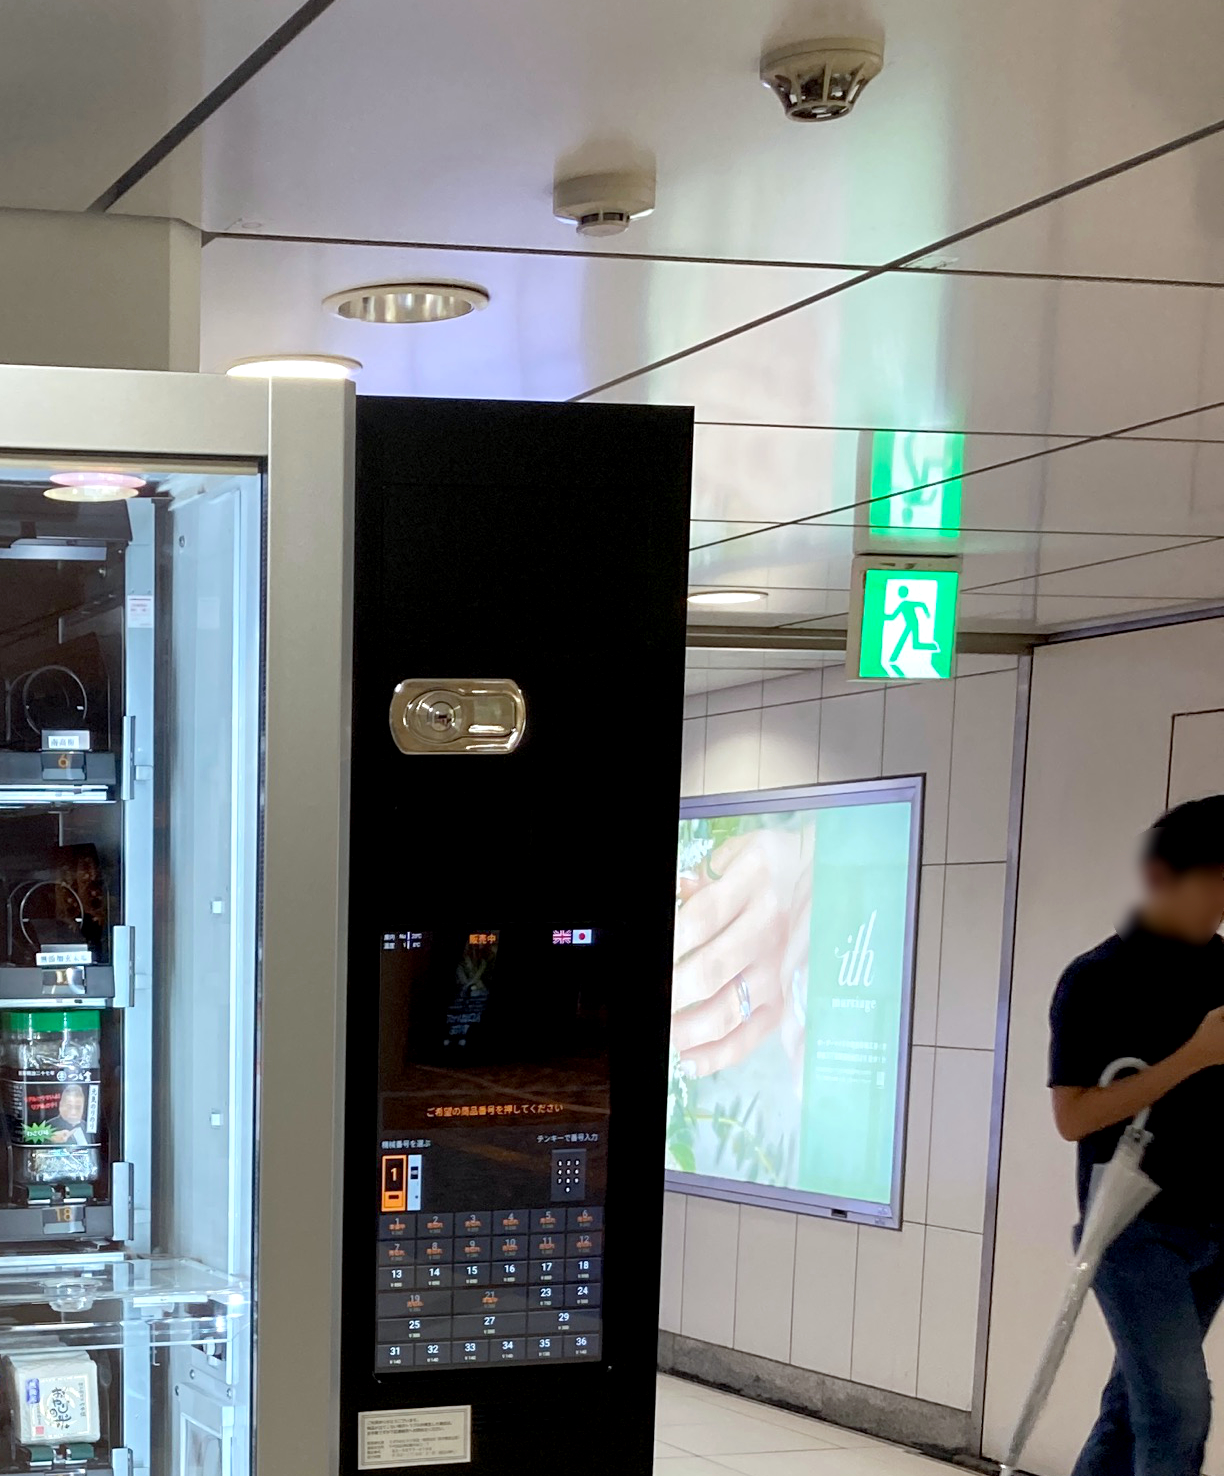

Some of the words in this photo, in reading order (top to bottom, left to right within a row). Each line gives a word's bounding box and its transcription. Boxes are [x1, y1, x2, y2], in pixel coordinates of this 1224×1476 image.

[57, 752, 69, 768] 6
[469, 933, 497, 945] 販売中
[831, 997, 877, 1013] marriage
[89, 1086, 97, 1130] 元気のりのり
[427, 1104, 563, 1117] ご希望の商品番号を押してください
[536, 1133, 598, 1143] テンキーで番号入力
[382, 1139, 431, 1149] 機械番号を選ぶ
[390, 1168, 398, 1181] 1
[55, 1207, 73, 1222] 18
[504, 1264, 515, 1273] 16
[541, 1263, 552, 1271] 17
[578, 1261, 589, 1270] 18
[392, 1270, 402, 1279] 13
[429, 1268, 440, 1277] 14
[467, 1266, 478, 1275] 15
[540, 1288, 552, 1297] 23
[577, 1287, 588, 1296] 24
[484, 1317, 495, 1325] 27
[558, 1313, 570, 1322] 29
[409, 1320, 421, 1329] 25
[502, 1341, 513, 1350] 34
[539, 1339, 551, 1348] 35
[576, 1337, 587, 1346] 36
[389, 1347, 400, 1356] 31
[427, 1345, 438, 1354] 32
[464, 1343, 476, 1352] 33
